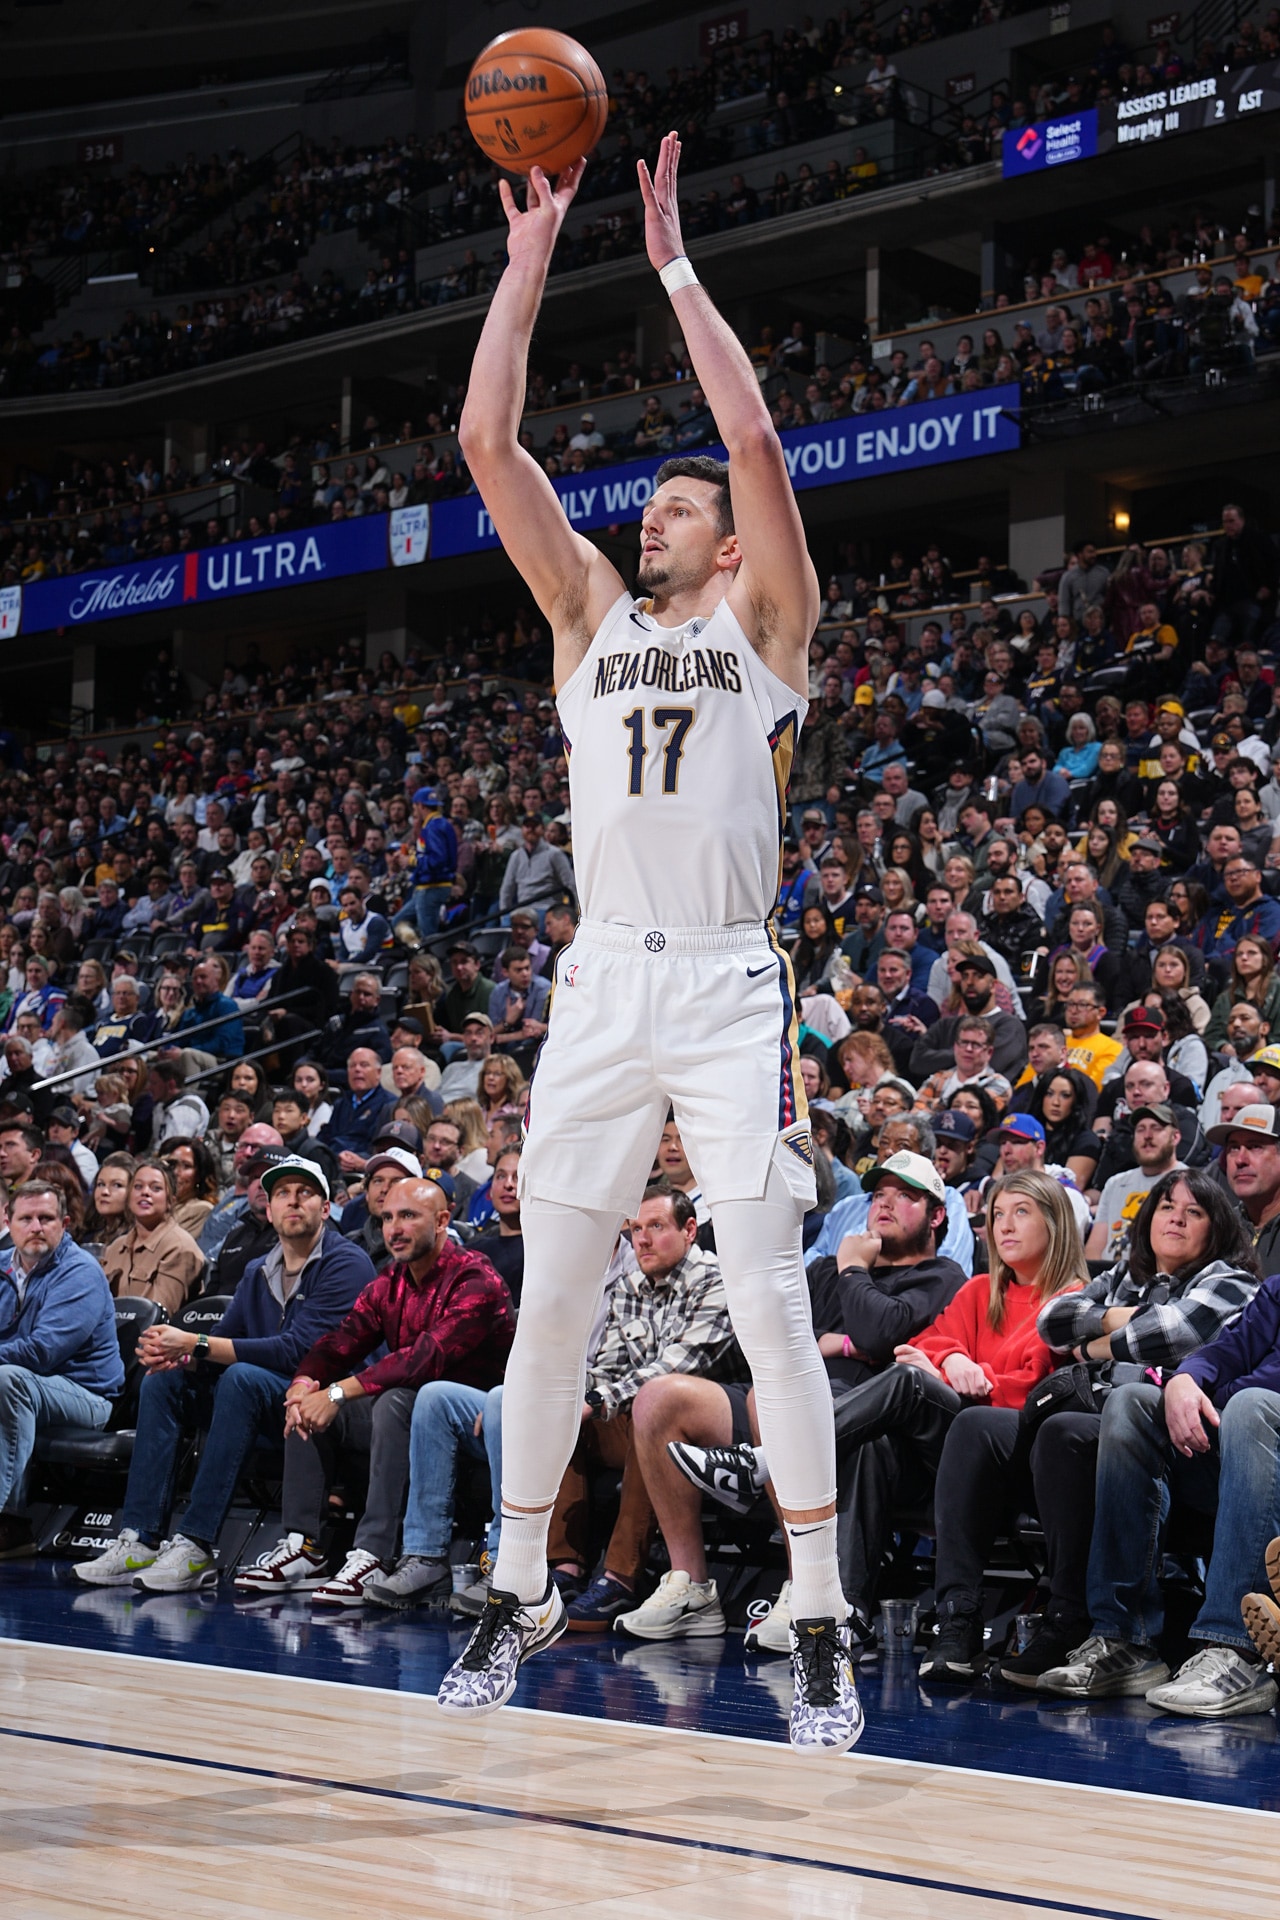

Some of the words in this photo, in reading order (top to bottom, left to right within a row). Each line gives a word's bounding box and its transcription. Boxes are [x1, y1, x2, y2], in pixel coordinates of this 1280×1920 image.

[707, 20, 740, 45] 338
[468, 68, 549, 103] Wilson
[1117, 95, 1167, 120] ASSISTS
[1169, 78, 1217, 106] LEADER
[1046, 120, 1081, 139] Select
[1117, 119, 1164, 144] Murphy
[1164, 112, 1180, 131] III
[1214, 99, 1225, 119] 2
[1238, 89, 1263, 112] AST
[84, 143, 114, 162] 334
[1046, 134, 1080, 152] Health
[784, 437, 846, 477] YOU
[856, 413, 963, 465] ENJOY
[973, 405, 1002, 442] IT
[69, 565, 179, 620] Michelob
[207, 536, 322, 591] ULTRA
[593, 653, 641, 699] NEW
[641, 646, 743, 695] ORLEANS
[621, 706, 696, 797] 17
[84, 1512, 112, 1526] CLUB
